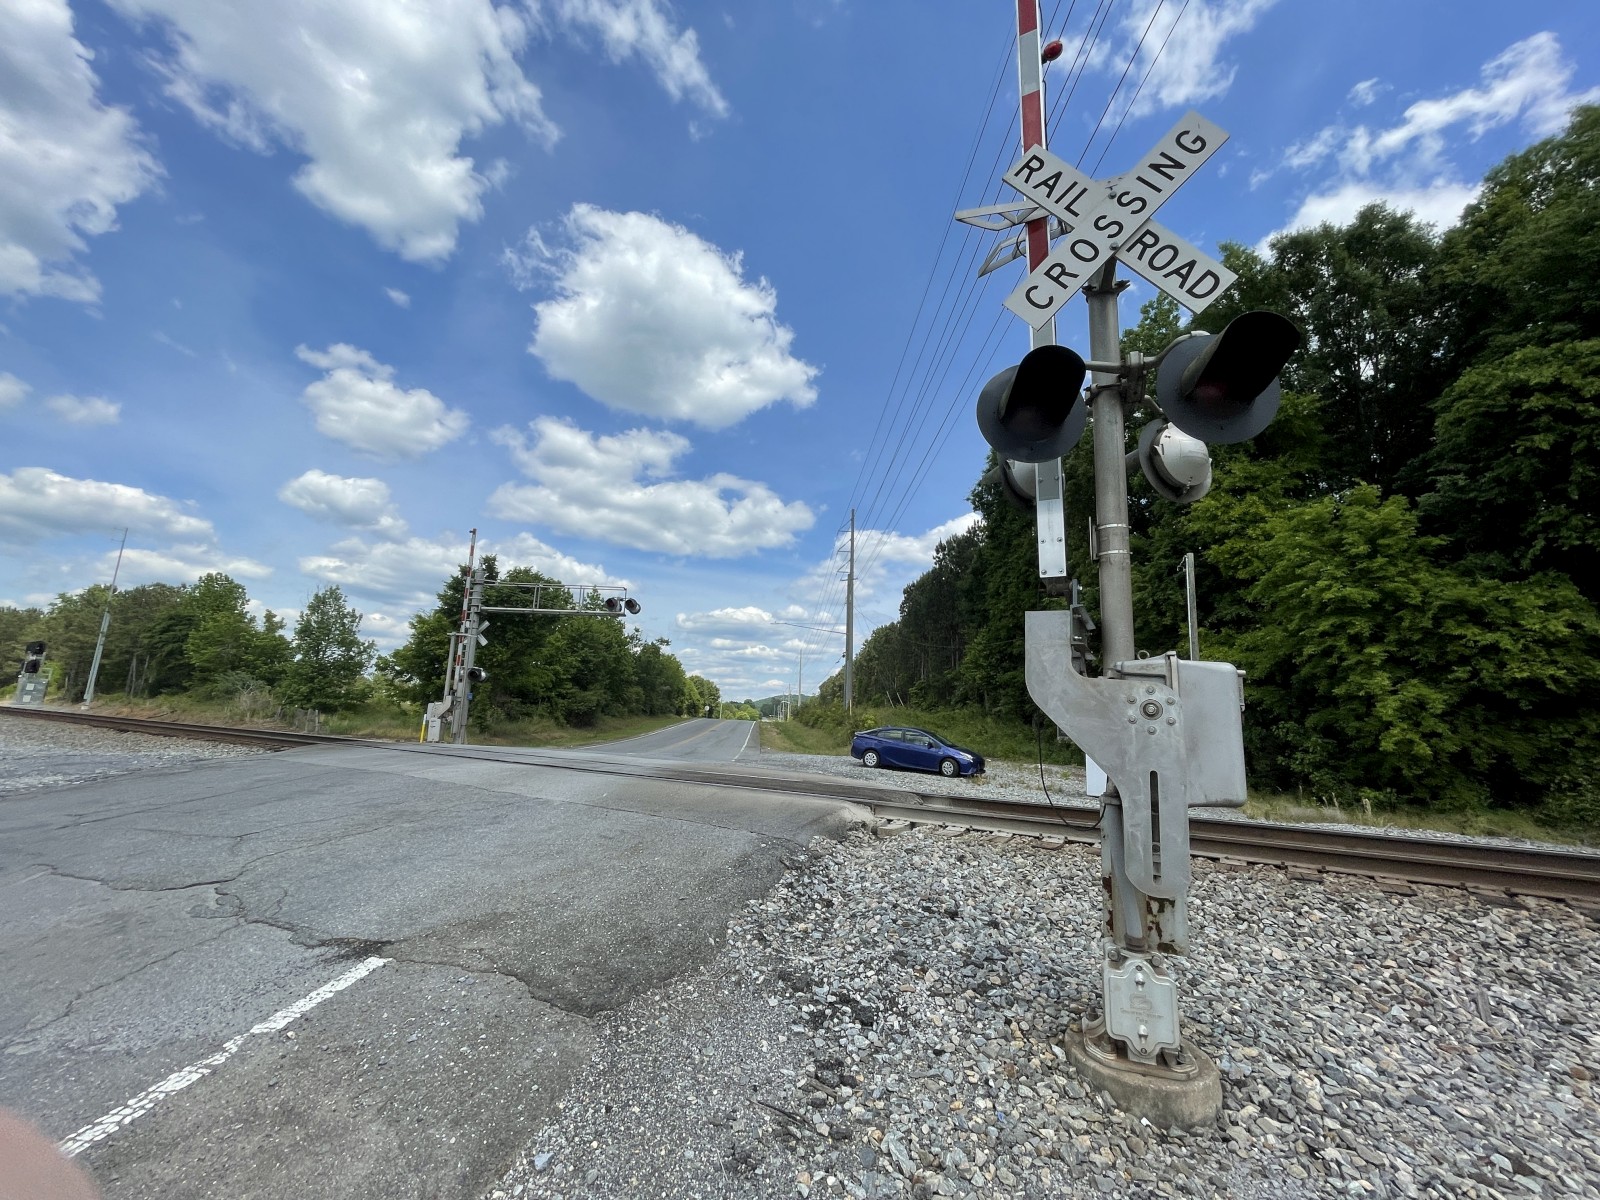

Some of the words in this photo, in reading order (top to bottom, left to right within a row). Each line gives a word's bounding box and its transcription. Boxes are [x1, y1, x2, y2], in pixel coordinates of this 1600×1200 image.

[1014, 154, 1088, 218] RAIL
[1125, 229, 1220, 299] ROAD
[1025, 130, 1207, 310] CROSSING
